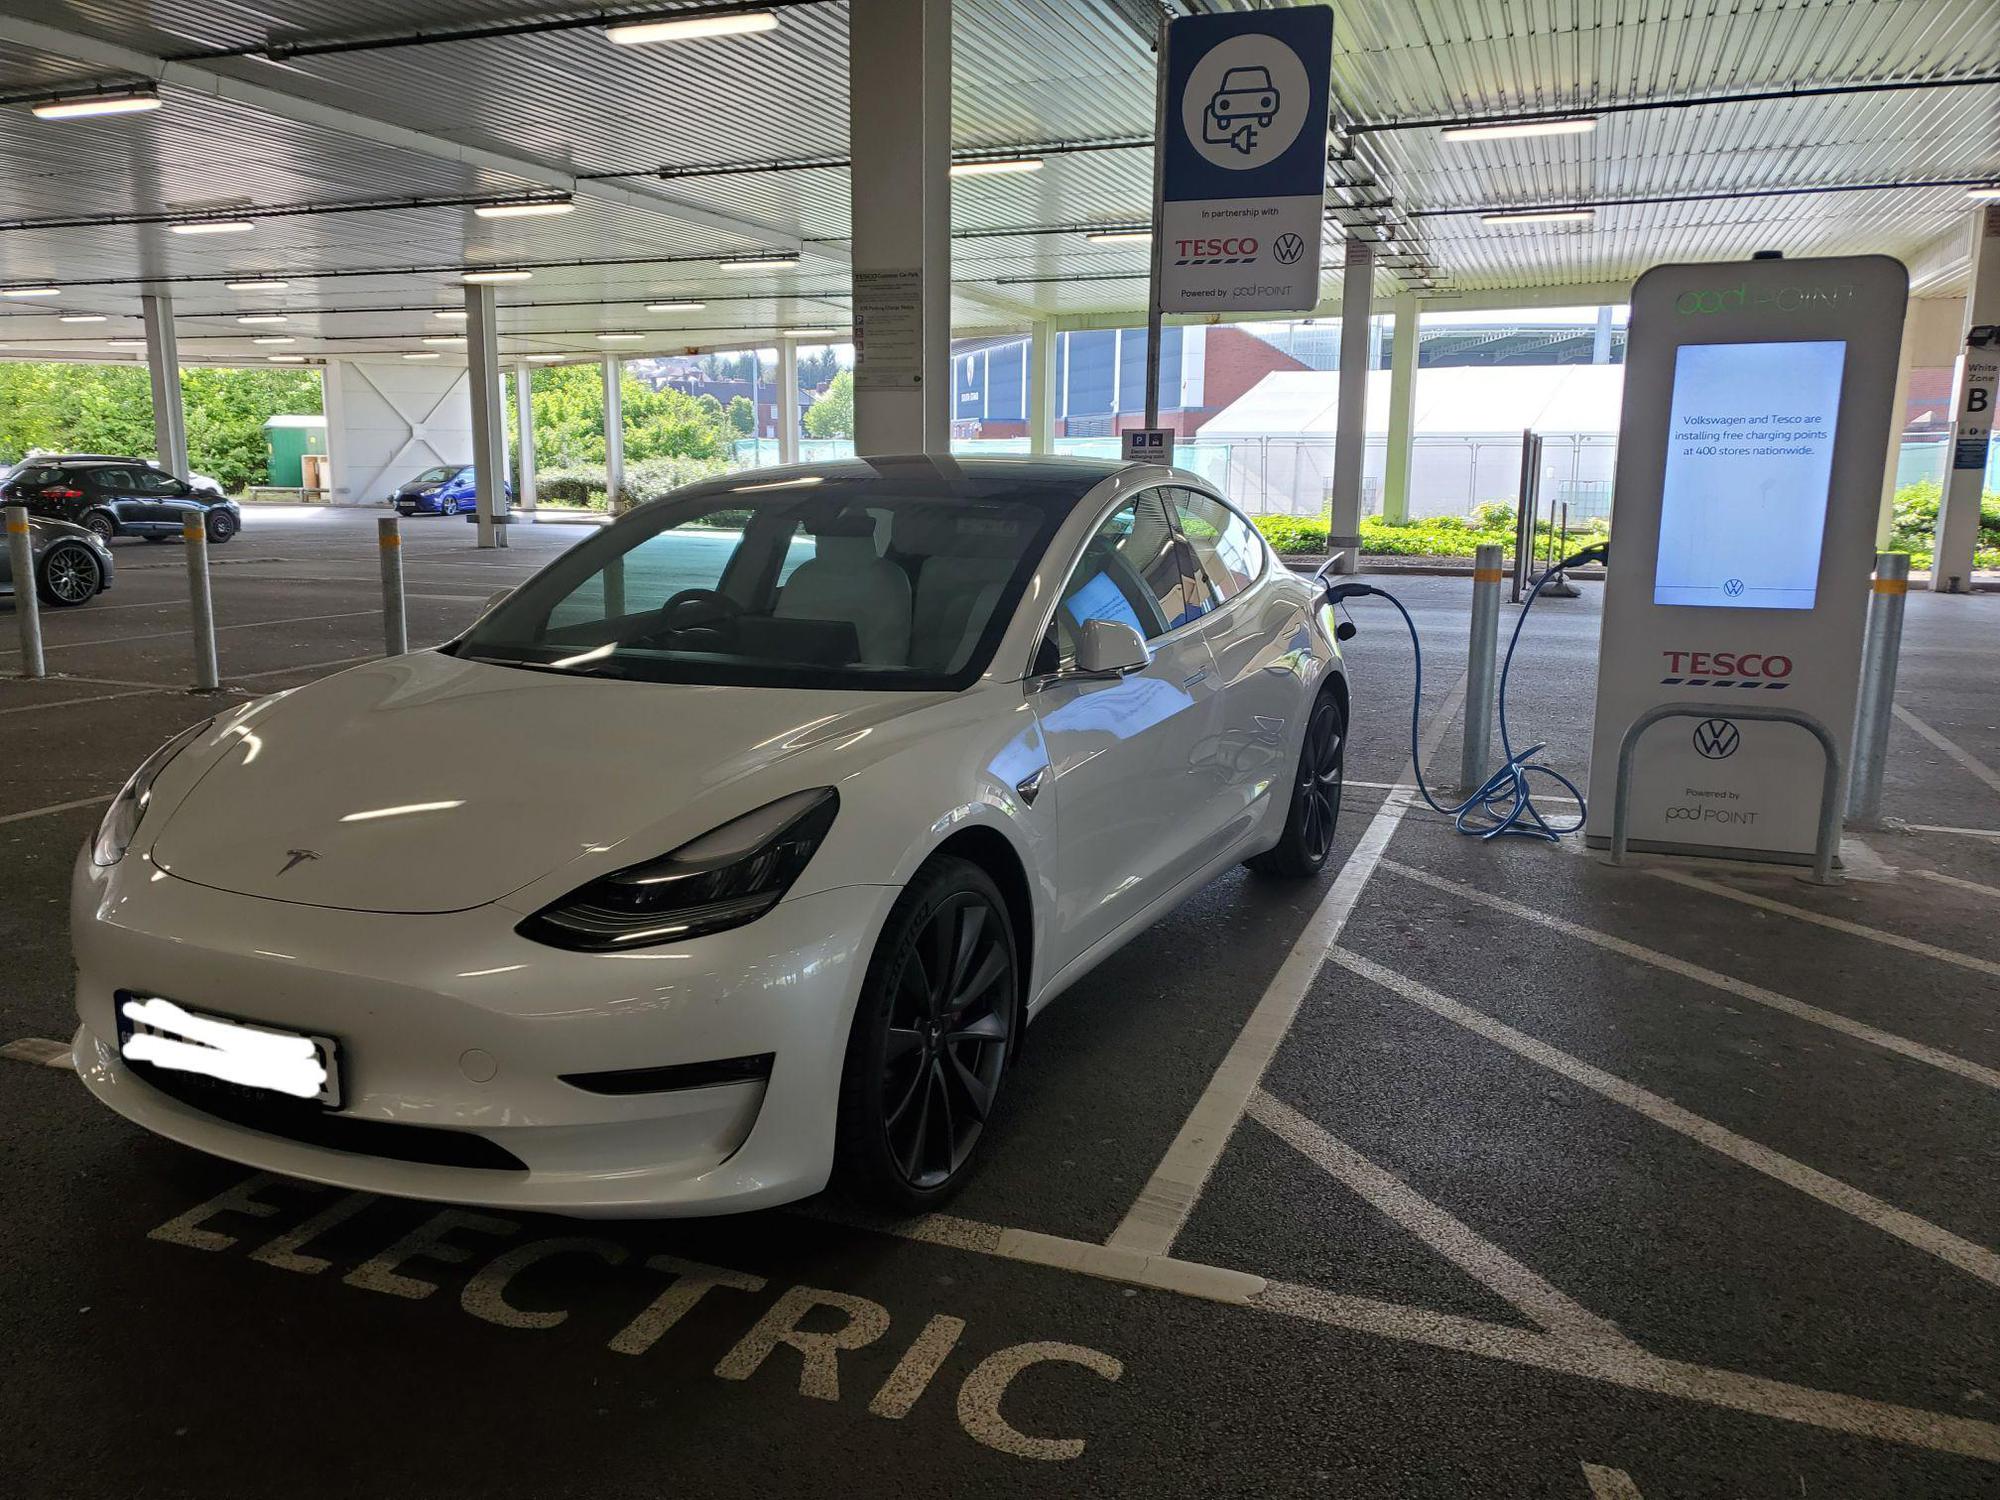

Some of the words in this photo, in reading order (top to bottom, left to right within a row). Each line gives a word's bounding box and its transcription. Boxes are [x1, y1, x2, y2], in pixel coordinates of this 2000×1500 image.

[1202, 210, 1210, 218] In
[1211, 208, 1260, 219] partnership
[1261, 207, 1279, 216] with
[1175, 237, 1259, 257] TESCO
[1181, 288, 1216, 298] Powered
[1217, 289, 1227, 298] by
[1968, 363, 1998, 372] White
[1967, 374, 1995, 382] Zone
[1967, 388, 1988, 412] B
[1683, 415, 1746, 427] Volkswagen
[1748, 414, 1769, 425] and
[1771, 414, 1803, 425] Tesco
[1804, 415, 1822, 424] are
[1674, 430, 1721, 443] installing
[1723, 430, 1744, 440] free
[1745, 430, 1792, 442] charging
[1793, 430, 1828, 441] points
[1683, 447, 1694, 456] at
[1695, 446, 1717, 456] 400
[1718, 446, 1750, 456] stores
[1752, 445, 1816, 456] nationwide.
[1663, 651, 1793, 678] TESCO
[1686, 788, 1727, 799] Powered
[1728, 791, 1740, 800] by
[1703, 808, 1760, 824] POINT
[145, 1171, 1123, 1461] ELECTRIC
